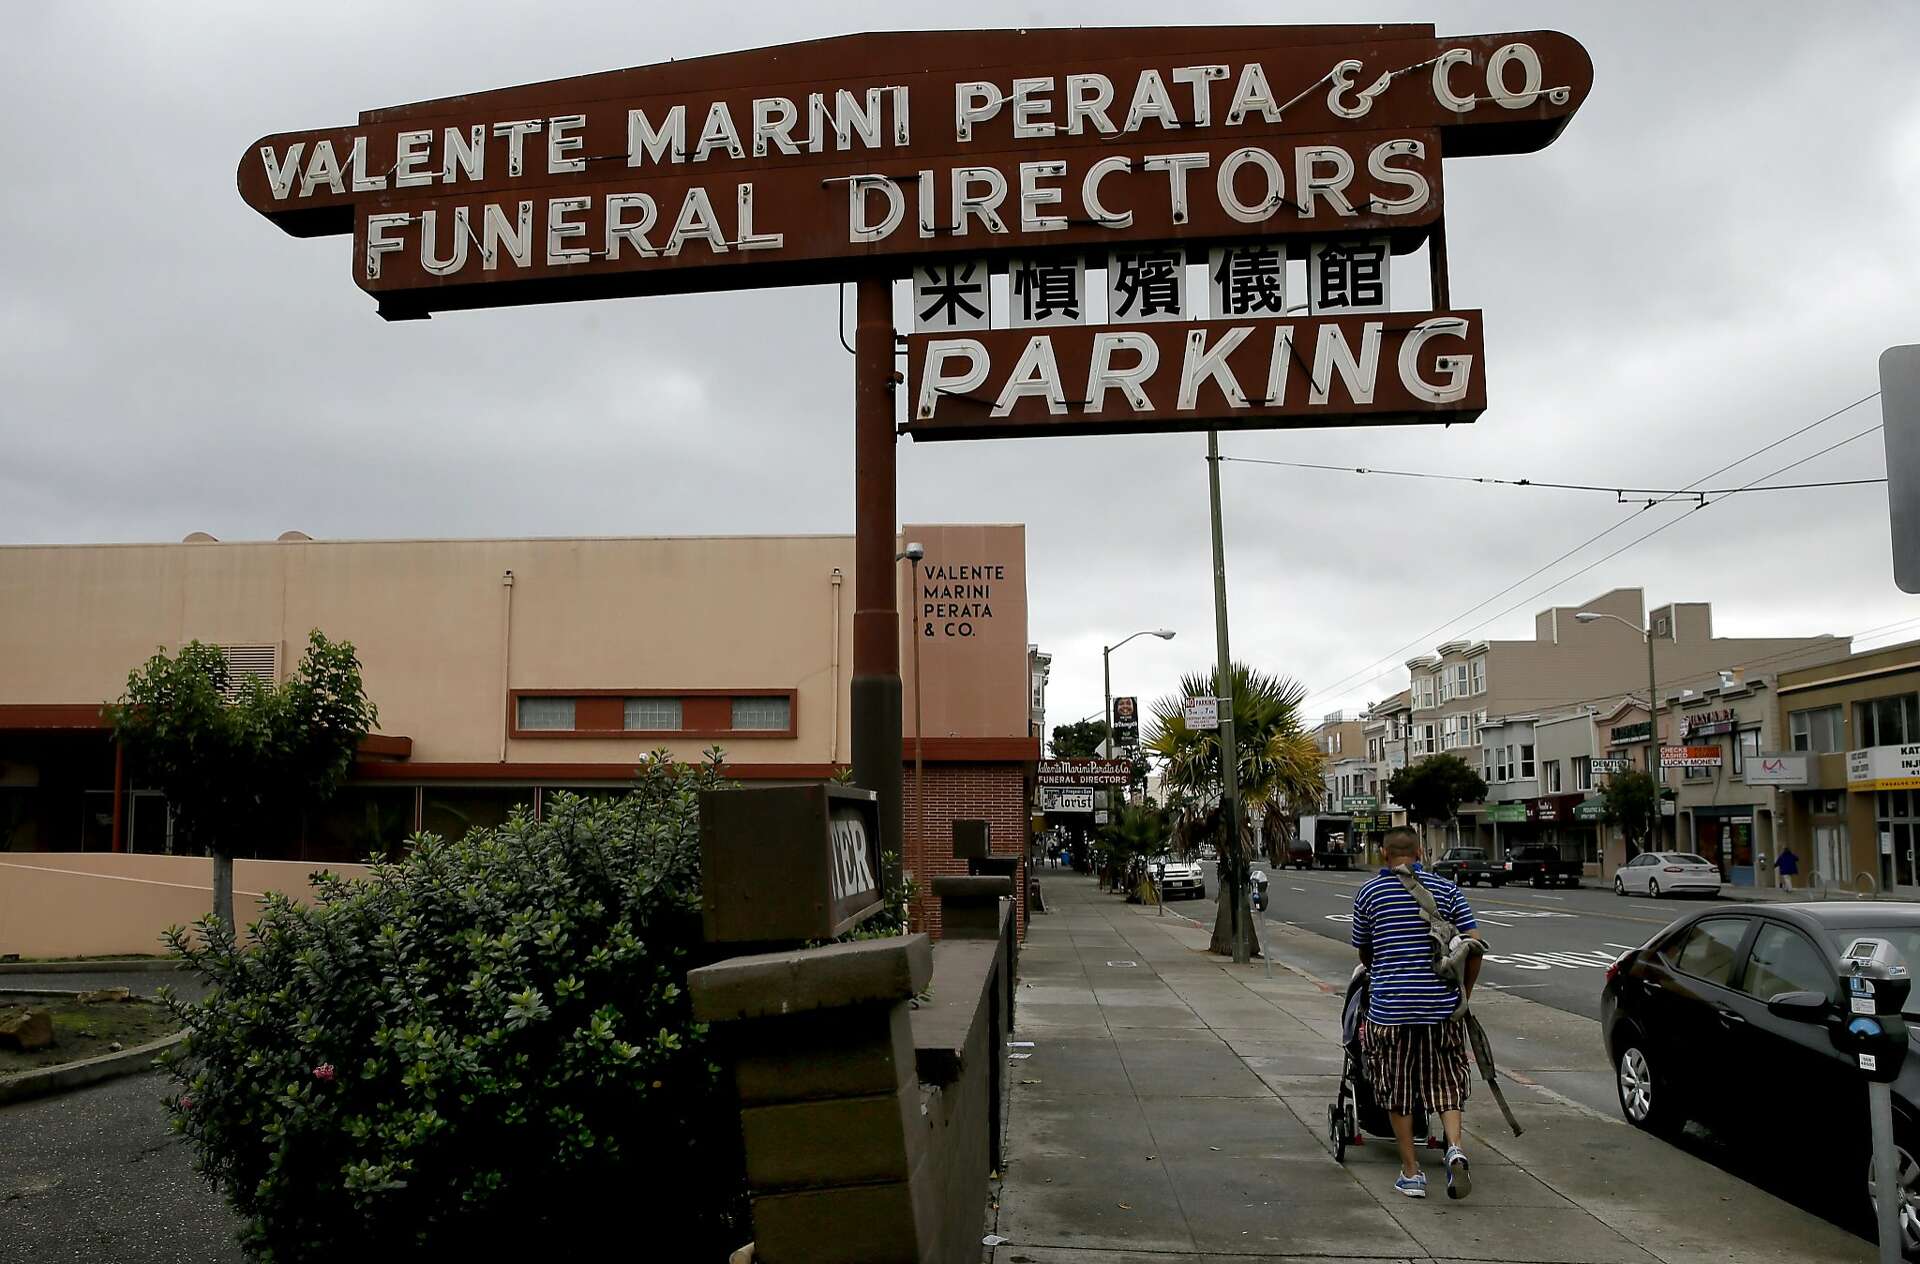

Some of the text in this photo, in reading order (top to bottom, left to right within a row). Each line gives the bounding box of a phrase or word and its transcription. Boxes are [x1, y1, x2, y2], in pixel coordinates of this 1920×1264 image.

[262, 114, 586, 201] VALENTE
[628, 84, 909, 167] MARINI
[954, 62, 1282, 143] PERATA
[1326, 58, 1391, 119] &
[367, 138, 1431, 280] FUNERAL DIRECTORS
[916, 317, 1474, 419] PARKING
[924, 565, 1004, 580] VALENTE
[924, 585, 990, 599] MARINI
[924, 604, 993, 618] PERATA
[924, 622, 976, 636] & CO.
[1061, 761, 1090, 774] Marini
[1038, 775, 1128, 784] FUNERAL DIRECTORS
